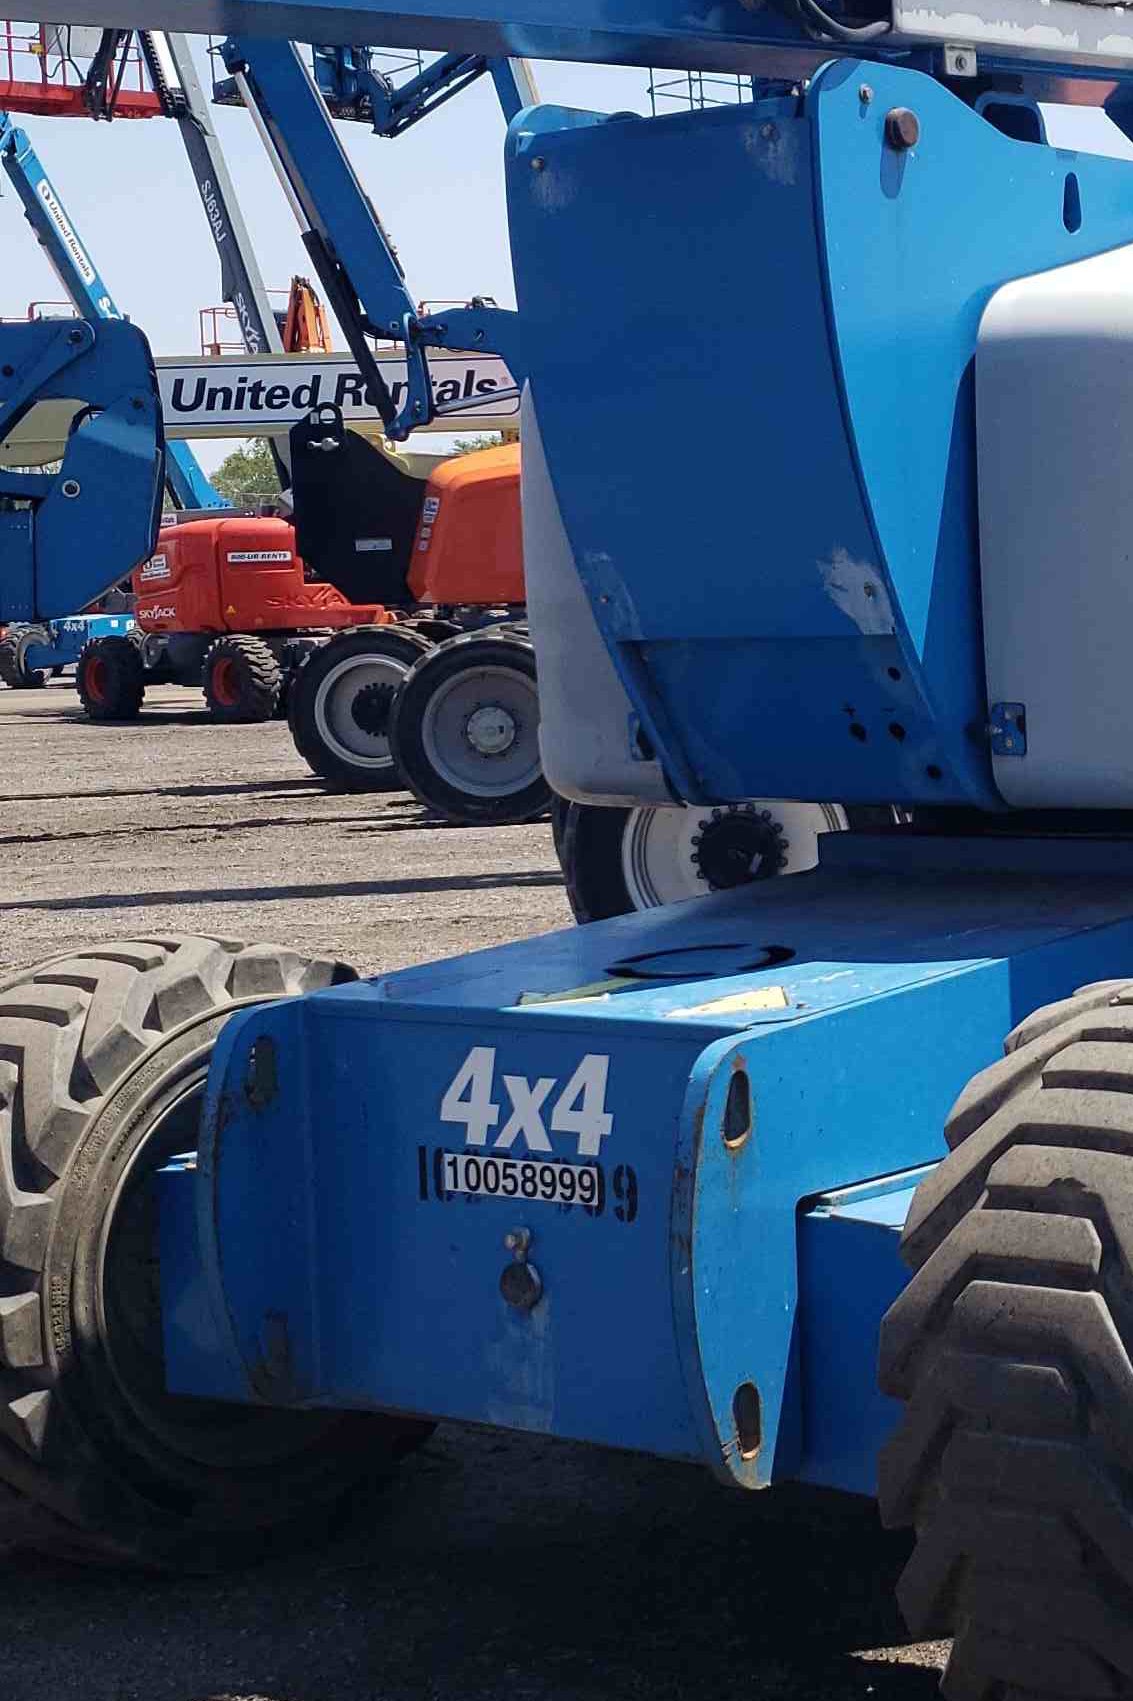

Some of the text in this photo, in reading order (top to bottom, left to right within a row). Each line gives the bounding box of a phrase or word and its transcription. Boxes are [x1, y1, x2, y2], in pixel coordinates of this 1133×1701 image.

[201, 180, 228, 243] SJ63AJ
[49, 202, 91, 278] United Rentals
[171, 369, 498, 411] United Rnals
[63, 619, 85, 632] 4x4
[139, 605, 176, 619] SKYJACK
[440, 1046, 614, 1156] 4x4
[447, 1156, 596, 1204] 10058999
